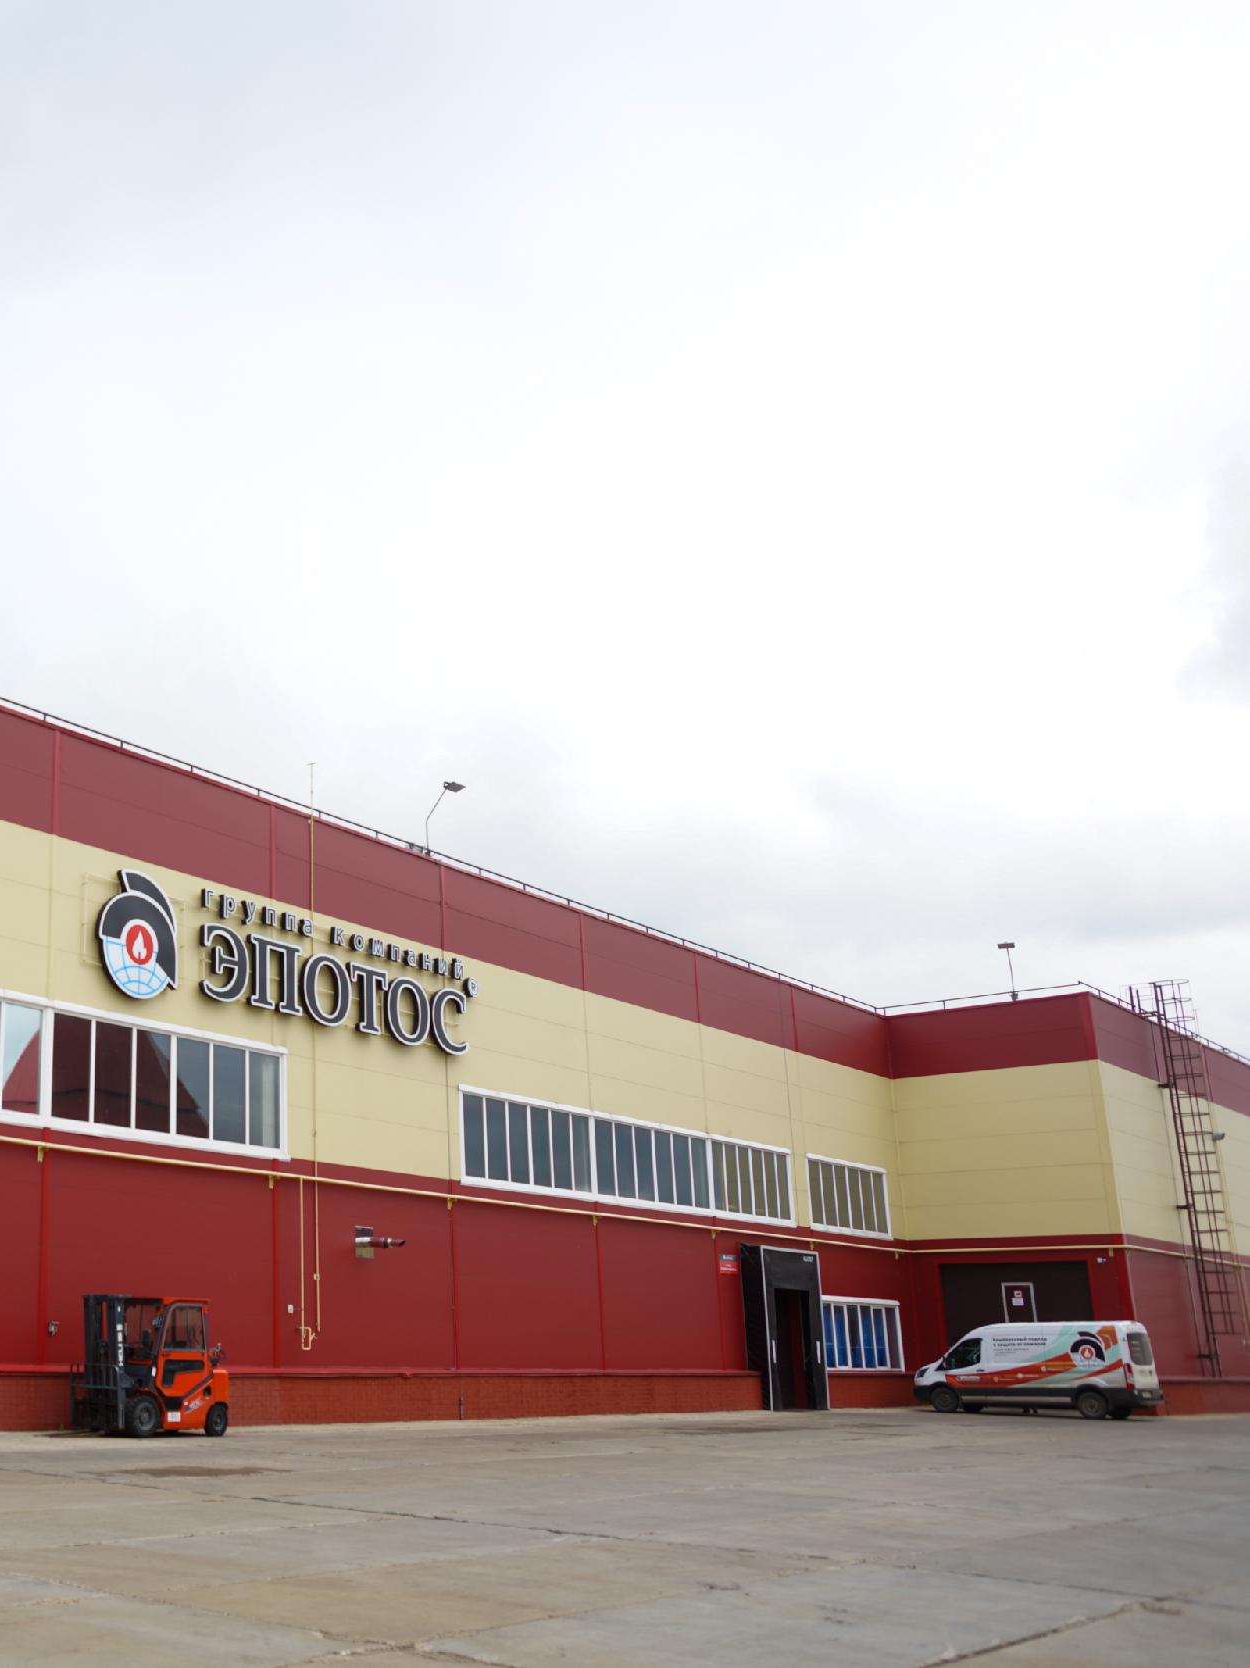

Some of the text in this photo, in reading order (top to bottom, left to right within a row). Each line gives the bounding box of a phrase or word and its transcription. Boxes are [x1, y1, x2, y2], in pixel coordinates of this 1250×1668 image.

[200, 923, 469, 1056] ЭПОТОС
[201, 888, 464, 980] группа компаний
